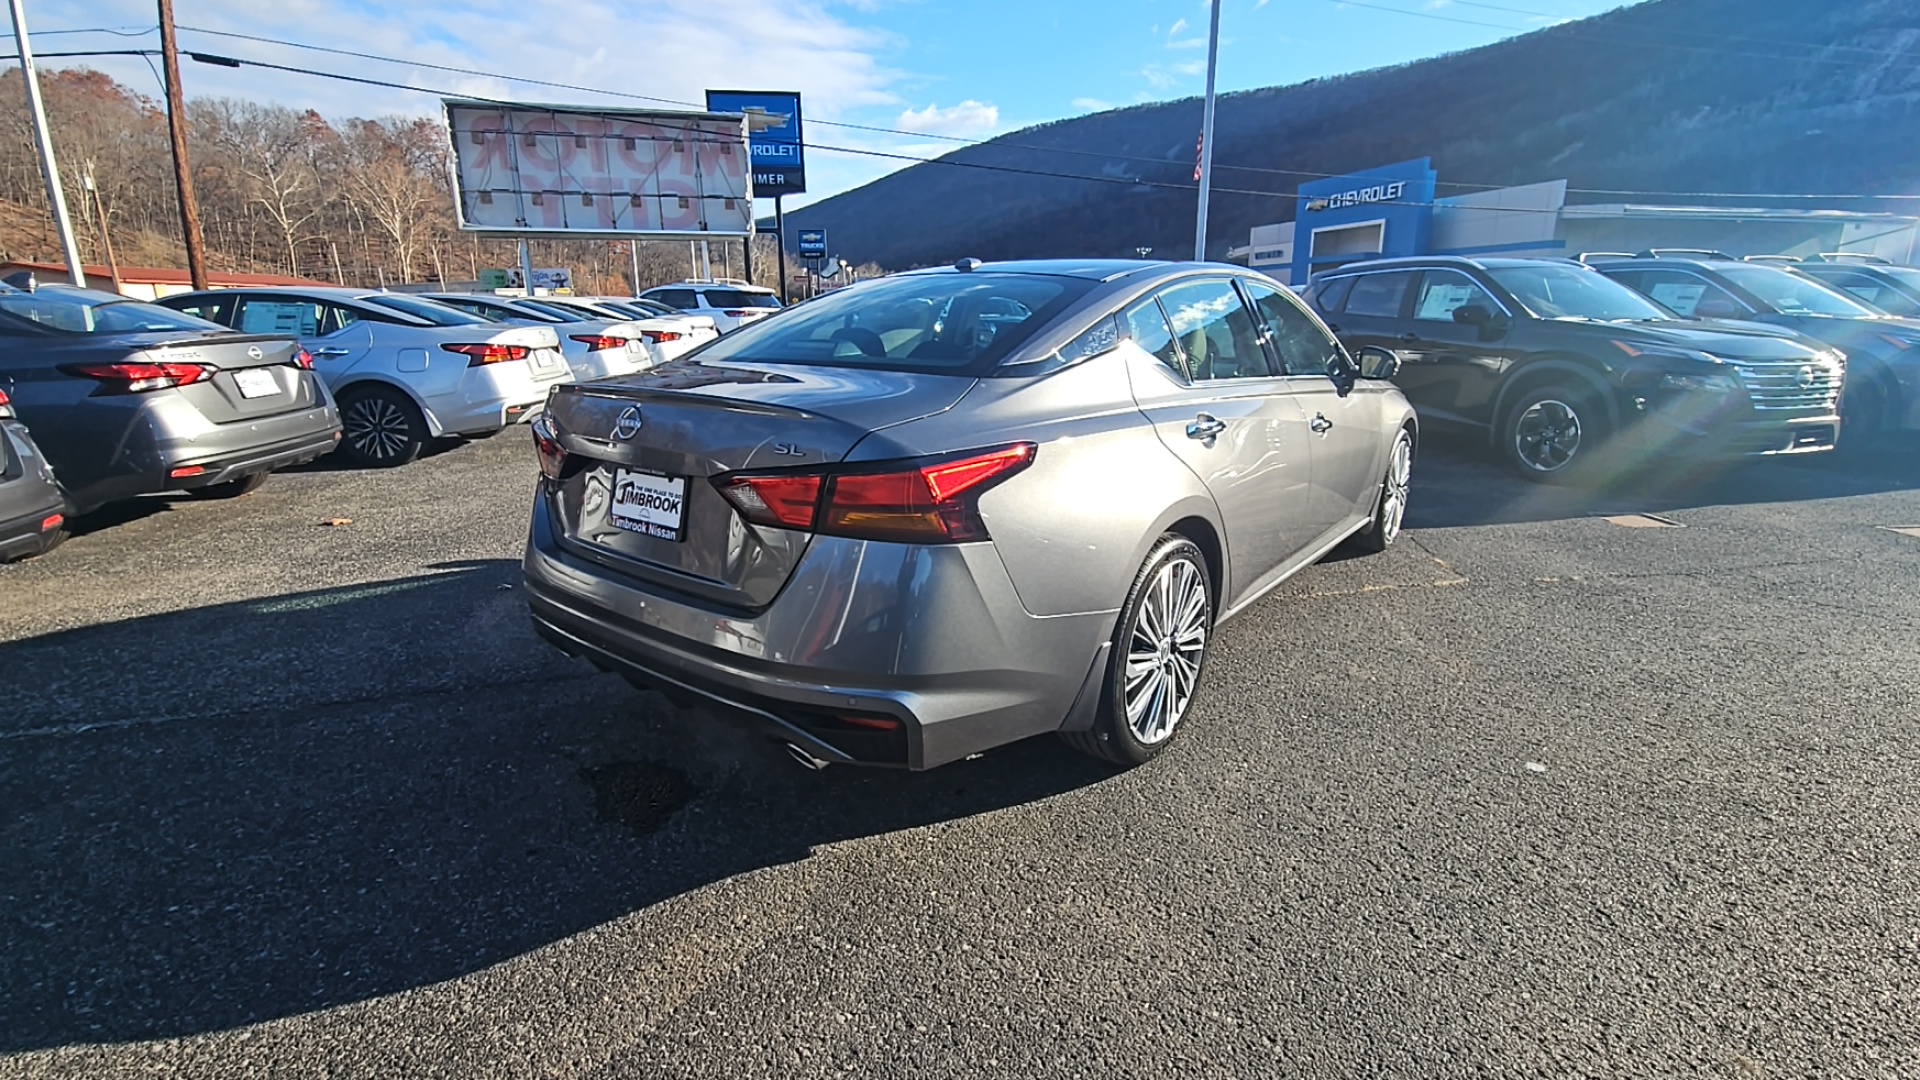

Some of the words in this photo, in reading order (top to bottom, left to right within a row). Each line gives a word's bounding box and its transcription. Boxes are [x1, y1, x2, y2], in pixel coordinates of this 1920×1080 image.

[749, 144, 796, 156] VROLET
[753, 173, 785, 185] IMER
[1329, 181, 1406, 210] CHEVROLET
[774, 443, 806, 457] SL
[644, 486, 652, 494] ONE
[653, 489, 667, 497] PLACE
[612, 515, 647, 533] Timbrook
[648, 523, 676, 541] Nissan
